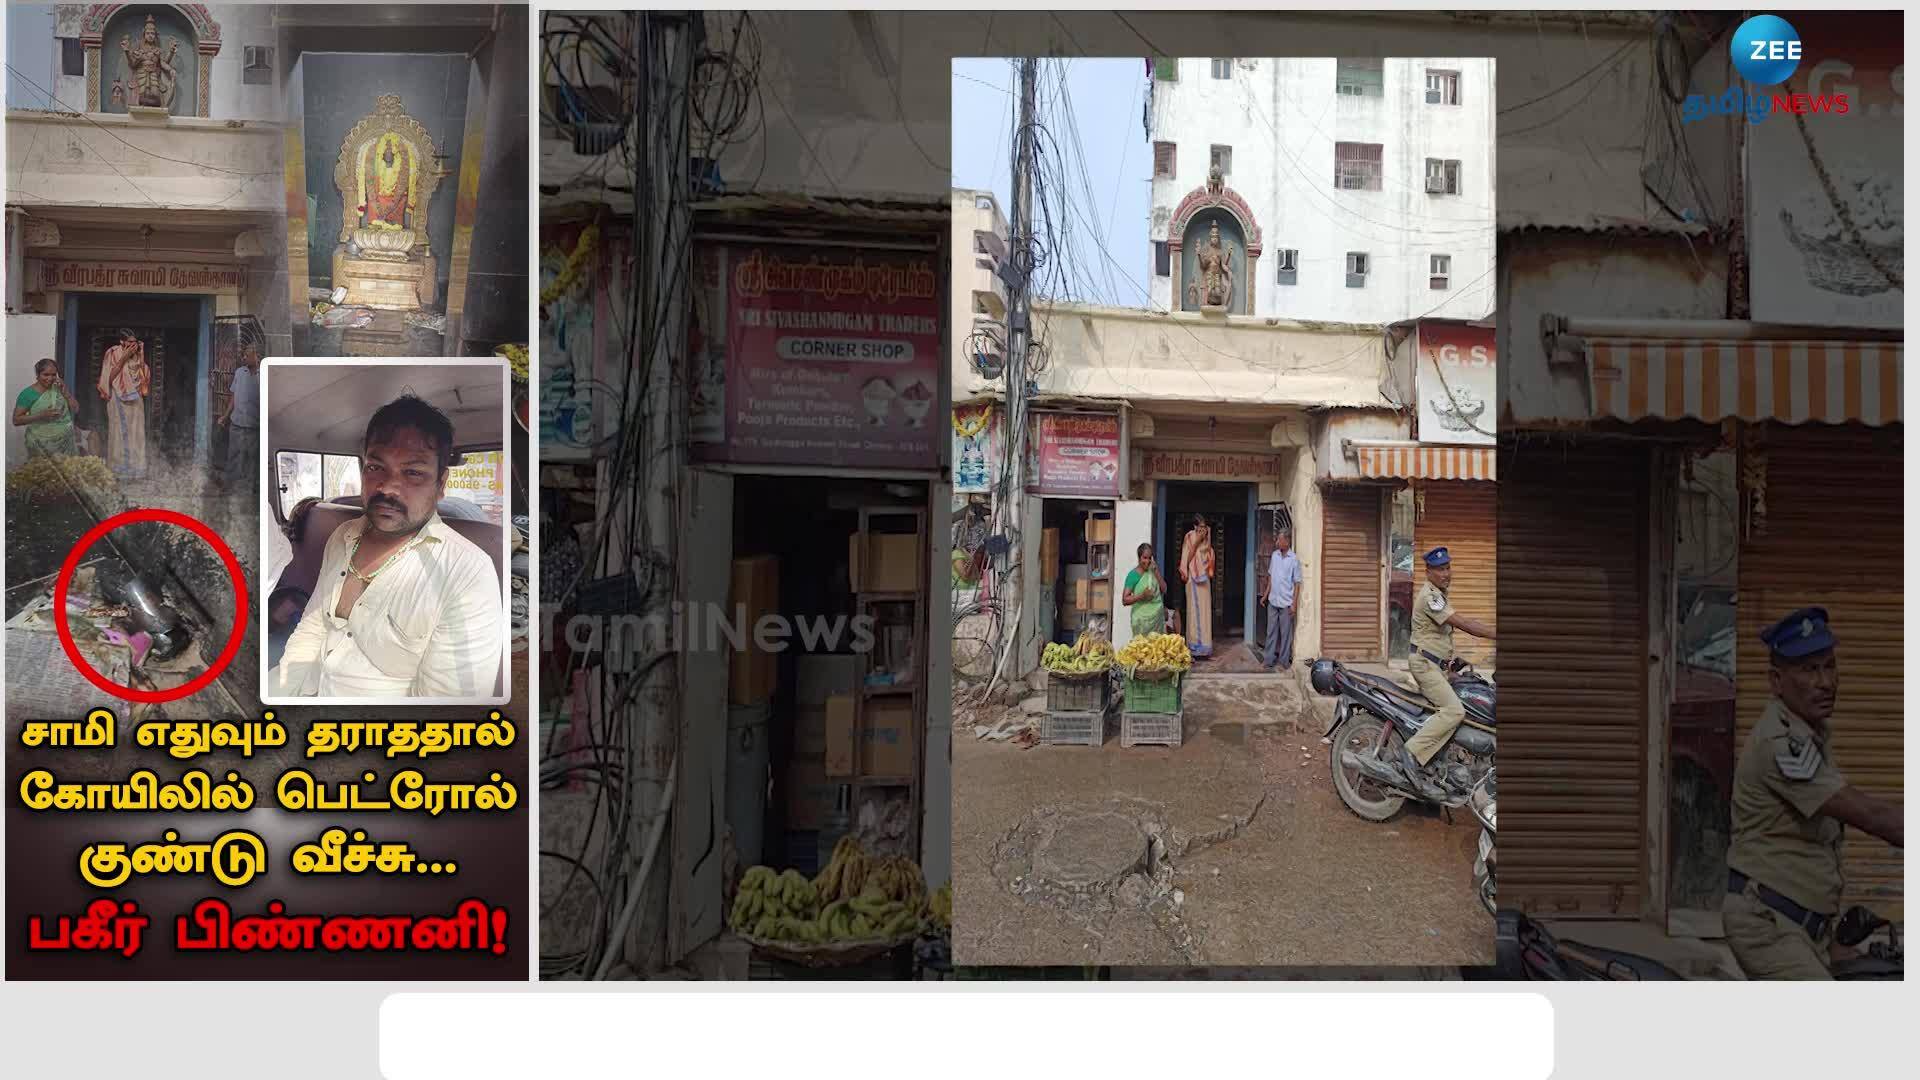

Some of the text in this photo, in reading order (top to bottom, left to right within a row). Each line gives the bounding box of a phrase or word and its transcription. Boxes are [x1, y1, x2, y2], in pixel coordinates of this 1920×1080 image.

[790, 341, 905, 359] CORNER SHOP
[775, 413, 831, 427] Products
